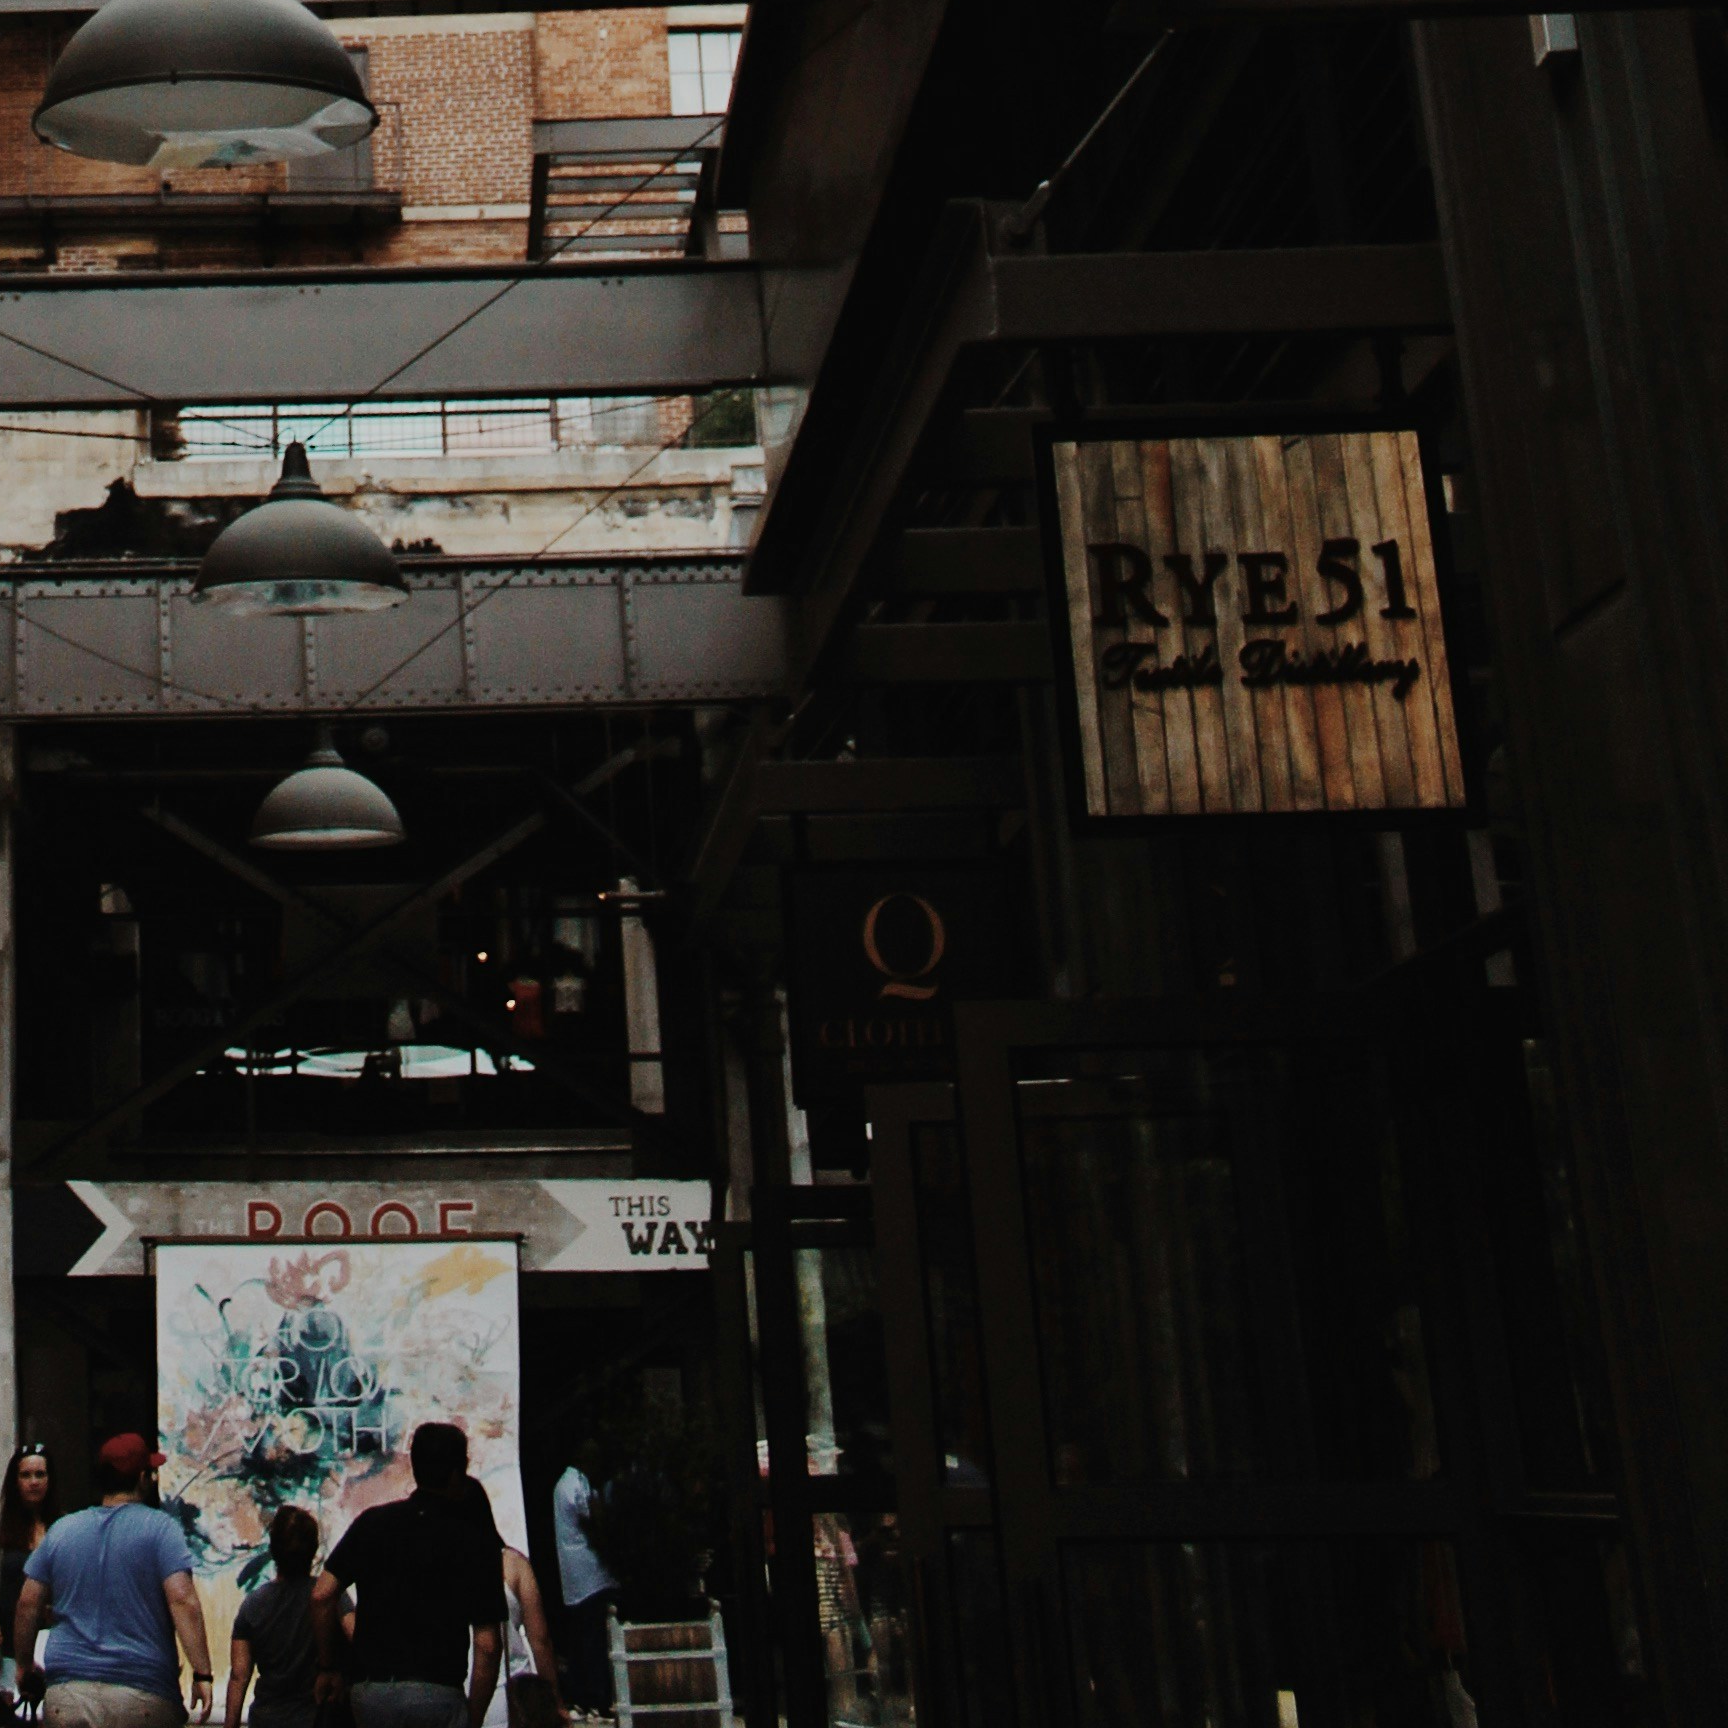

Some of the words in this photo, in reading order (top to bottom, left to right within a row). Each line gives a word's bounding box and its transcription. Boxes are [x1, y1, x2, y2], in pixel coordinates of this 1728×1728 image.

[1087, 541, 1298, 628] RYE
[1315, 538, 1417, 625] 51
[609, 1196, 672, 1216] THIS
[621, 1221, 715, 1255] WAY
